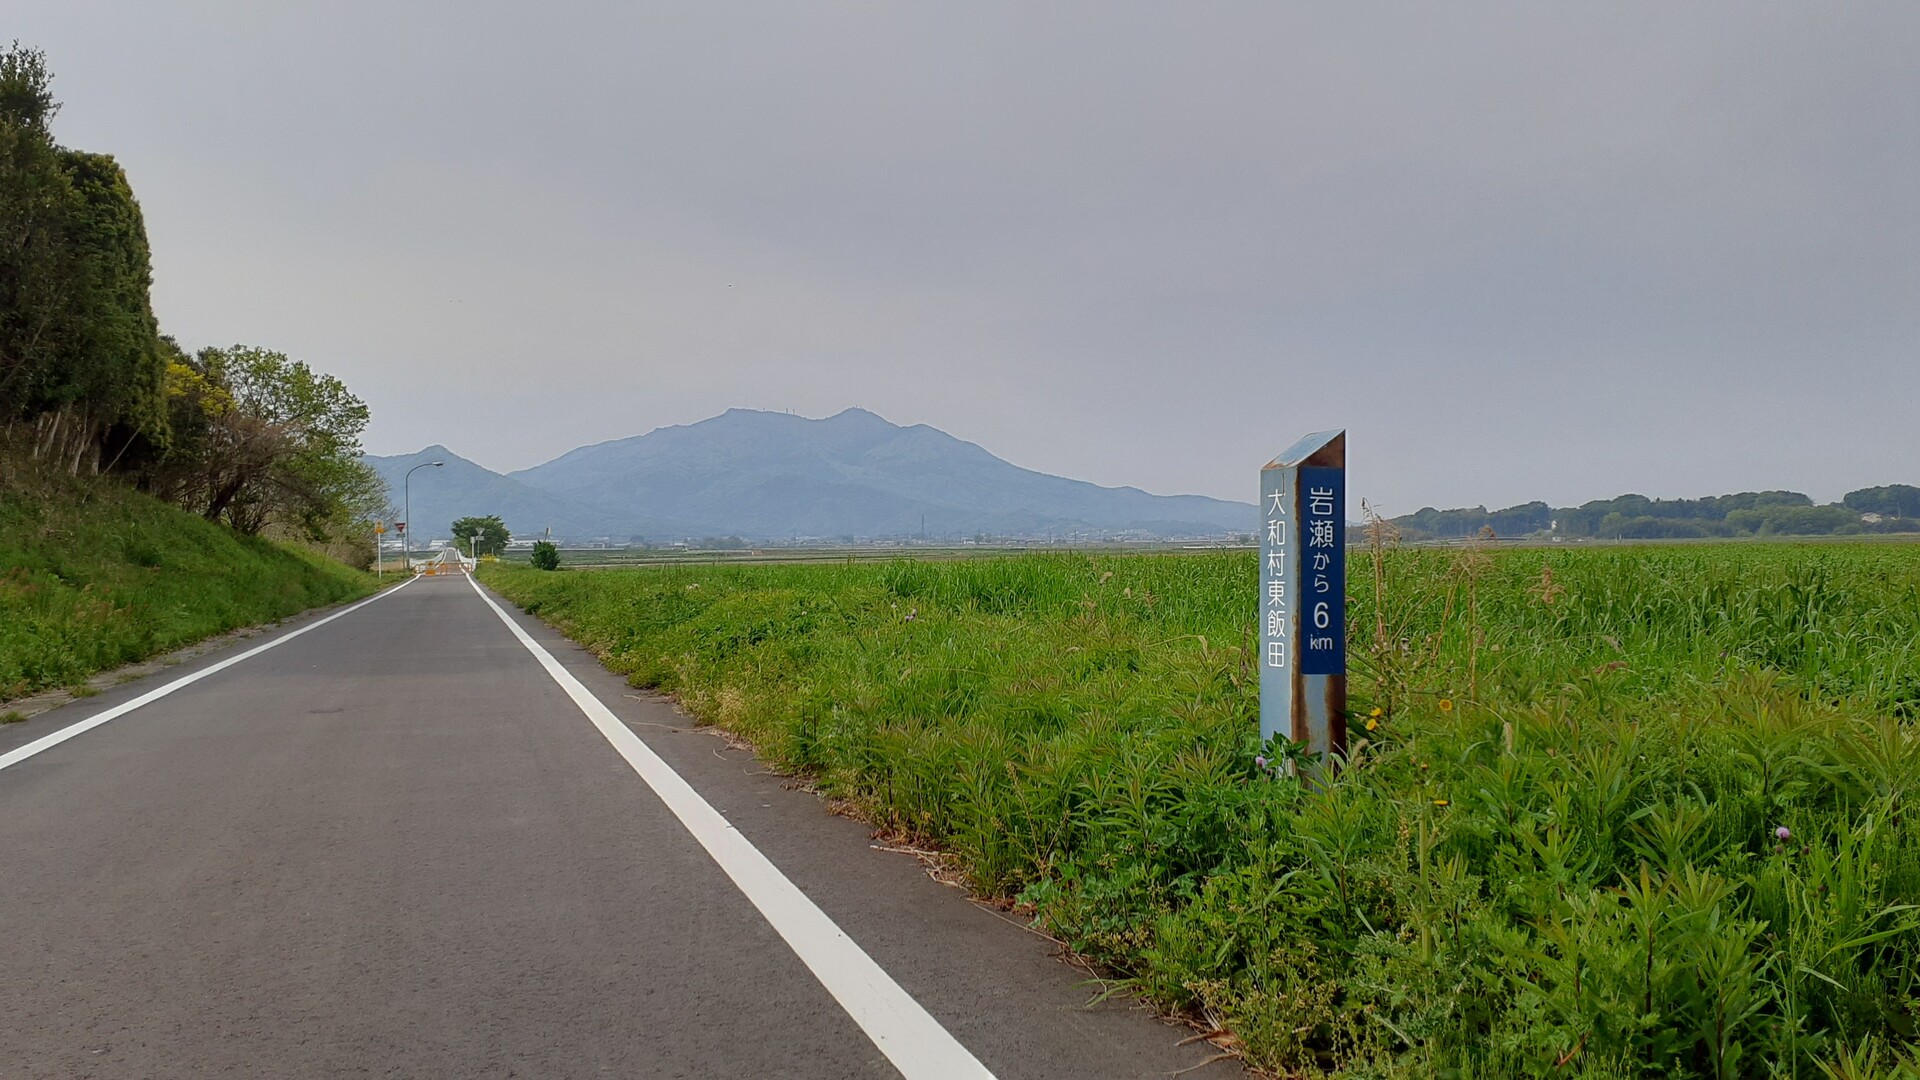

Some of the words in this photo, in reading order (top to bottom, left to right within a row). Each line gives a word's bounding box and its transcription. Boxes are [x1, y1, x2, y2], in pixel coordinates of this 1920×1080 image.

[1267, 489, 1286, 668] 大和村東飯田
